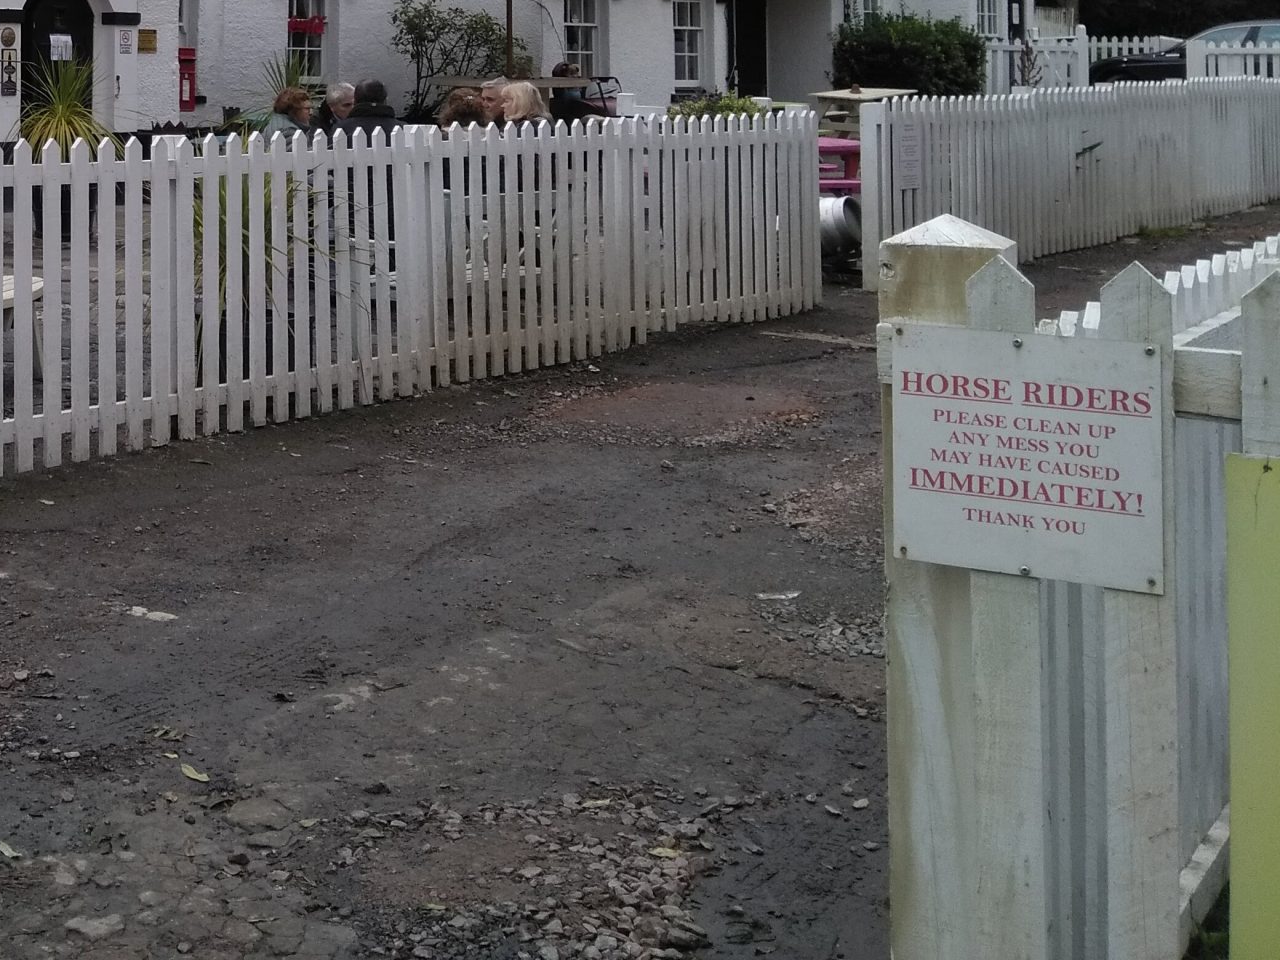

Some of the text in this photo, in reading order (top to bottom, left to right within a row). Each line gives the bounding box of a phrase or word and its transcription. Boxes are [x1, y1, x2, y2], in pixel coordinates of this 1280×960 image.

[901, 371, 1152, 415] HORSE RIDERS
[933, 408, 1116, 440] PLEASE CLEAN UP
[948, 431, 1100, 459] ANY MESS YOU
[930, 448, 1120, 481] MAY HAVE CAUSED
[909, 467, 1144, 513] IMMEDIATELY!
[962, 507, 1086, 535] THANK YOU
